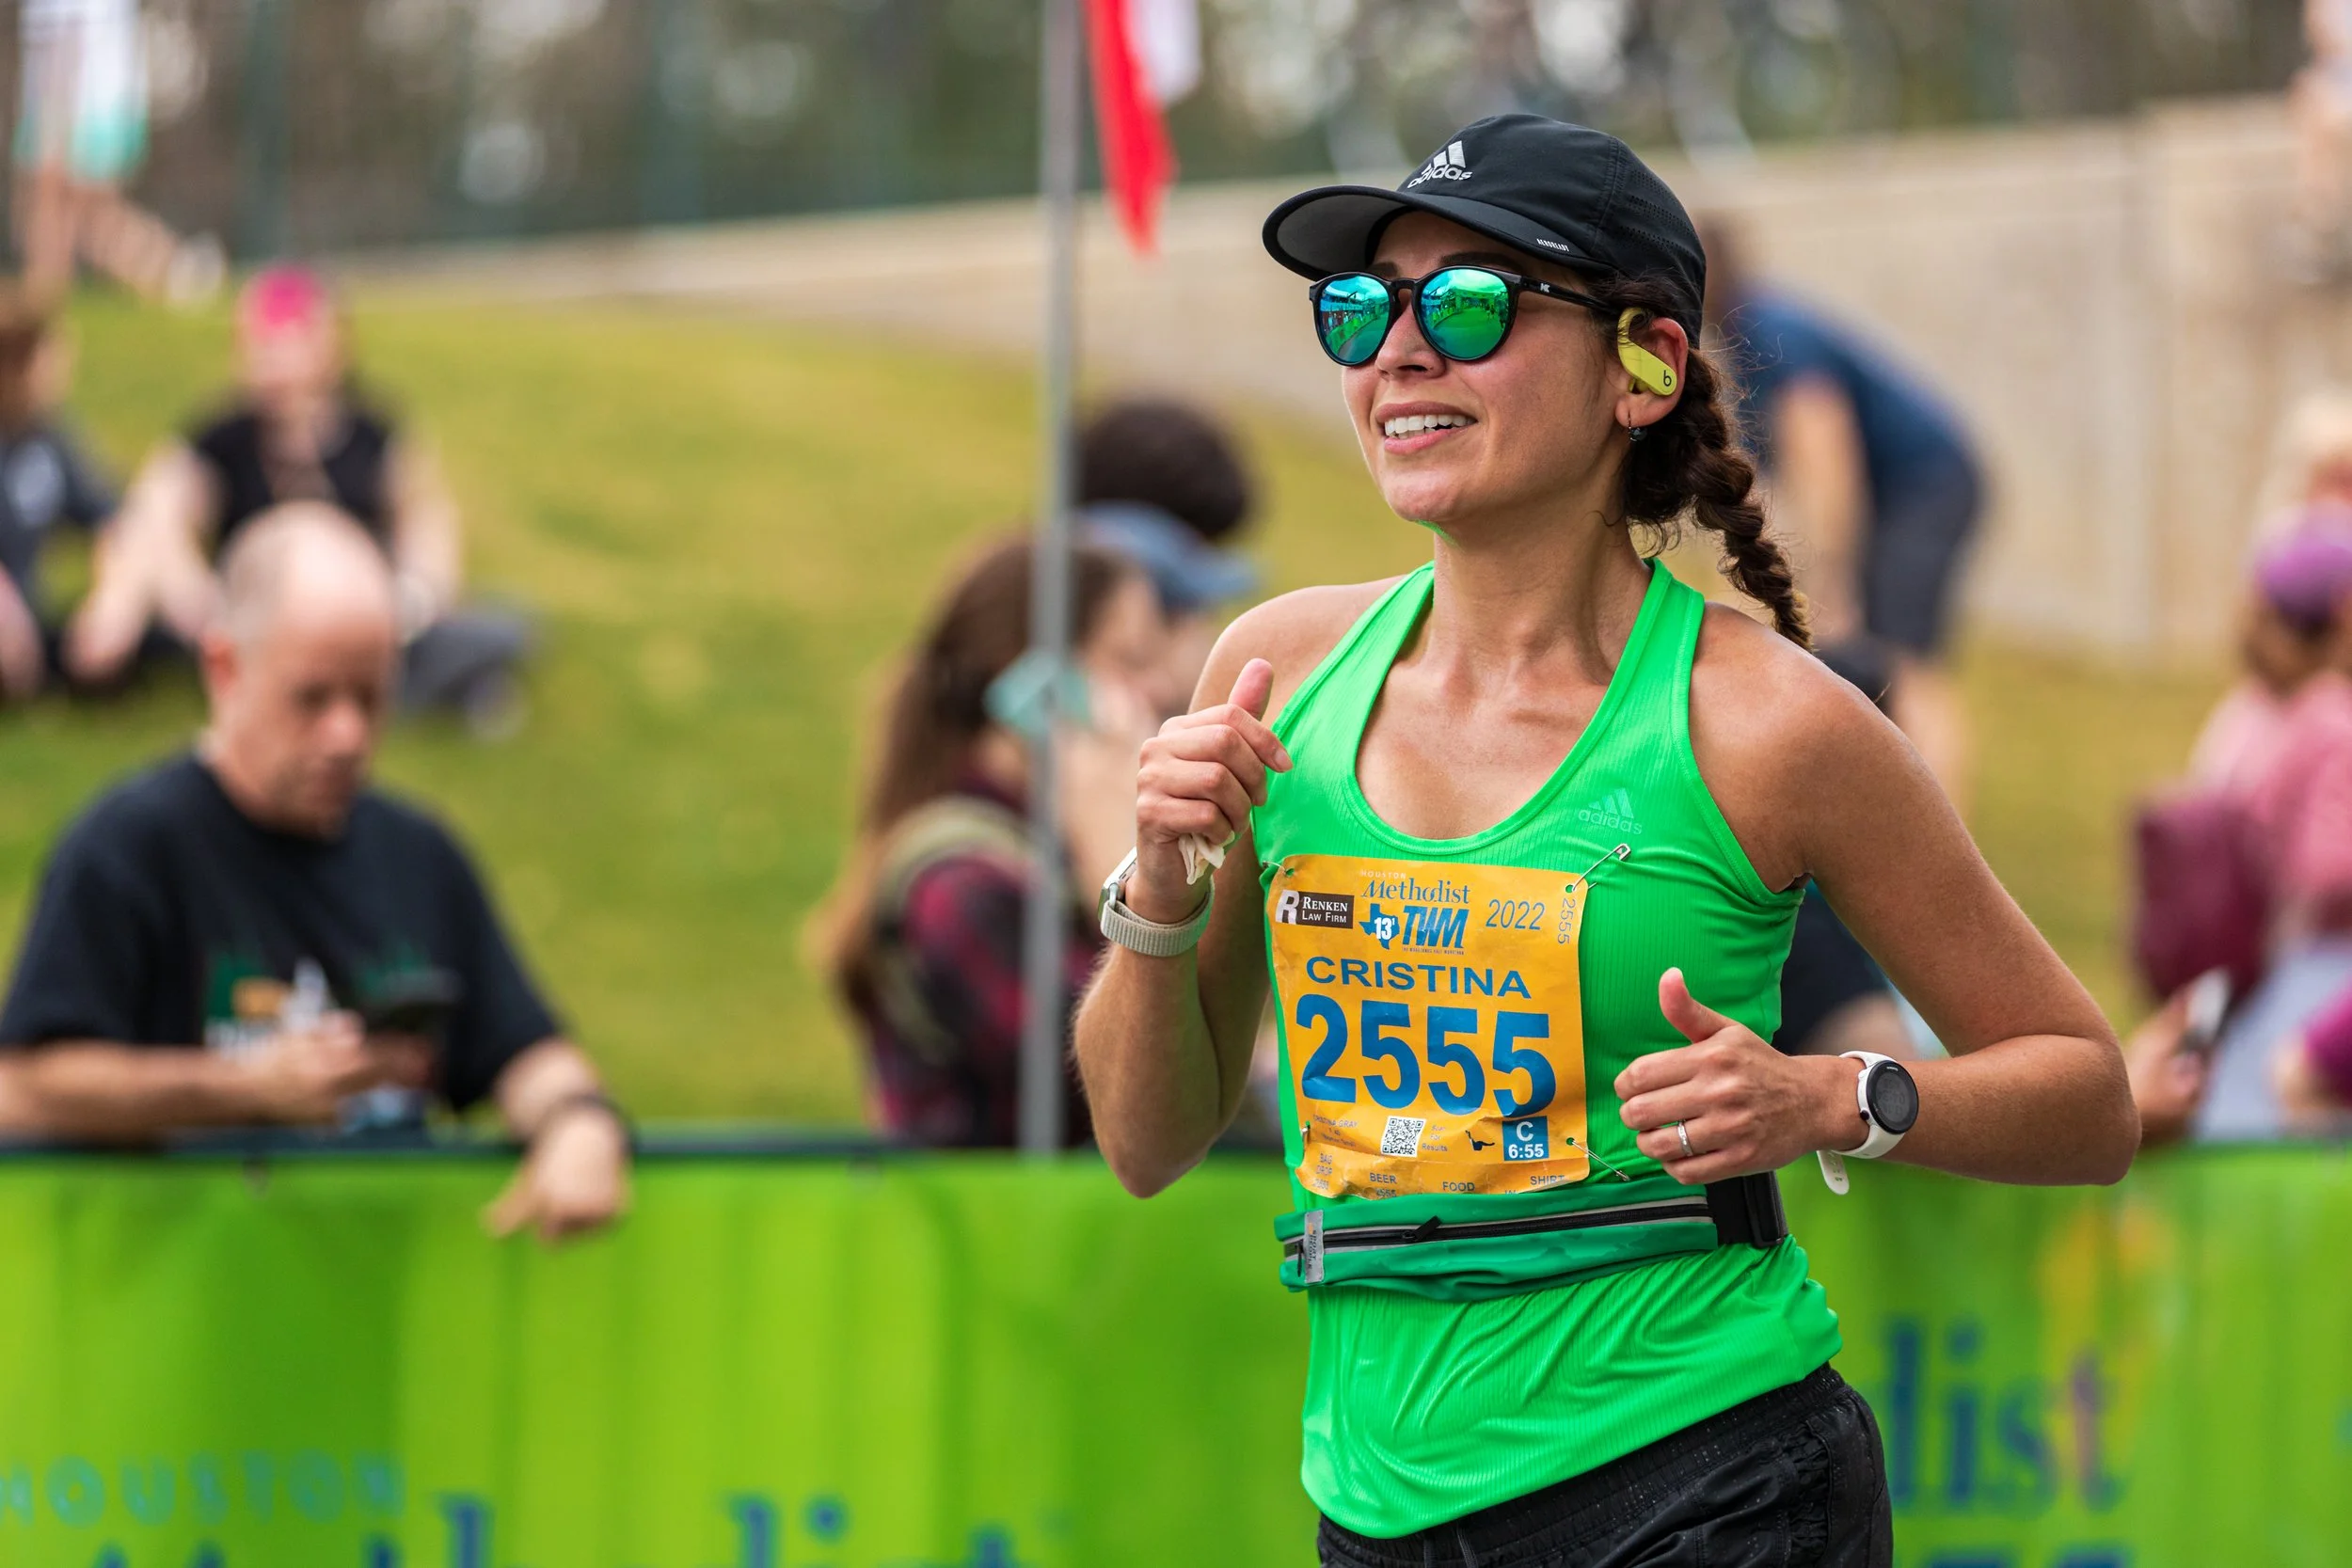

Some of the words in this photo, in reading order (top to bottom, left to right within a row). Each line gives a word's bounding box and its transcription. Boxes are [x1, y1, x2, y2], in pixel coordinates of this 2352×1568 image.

[1407, 164, 1472, 188] adidas
[1578, 809, 1643, 835] adidas
[1361, 870, 1406, 879] HOUSTON
[1361, 878, 1470, 904] Methodist
[1302, 896, 1348, 912] RENKEN
[1486, 899, 1545, 930] 2022
[1402, 905, 1470, 948] TWM
[1557, 897, 1577, 944] 2555
[1306, 956, 1532, 999] CRISTINA
[1295, 993, 1556, 1118] 2555
[1516, 1121, 1534, 1141] C
[1422, 1143, 1448, 1152] Results
[1508, 1144, 1544, 1159] 6:55
[1370, 1172, 1397, 1184] BEER
[1442, 1181, 1475, 1192] FOOD
